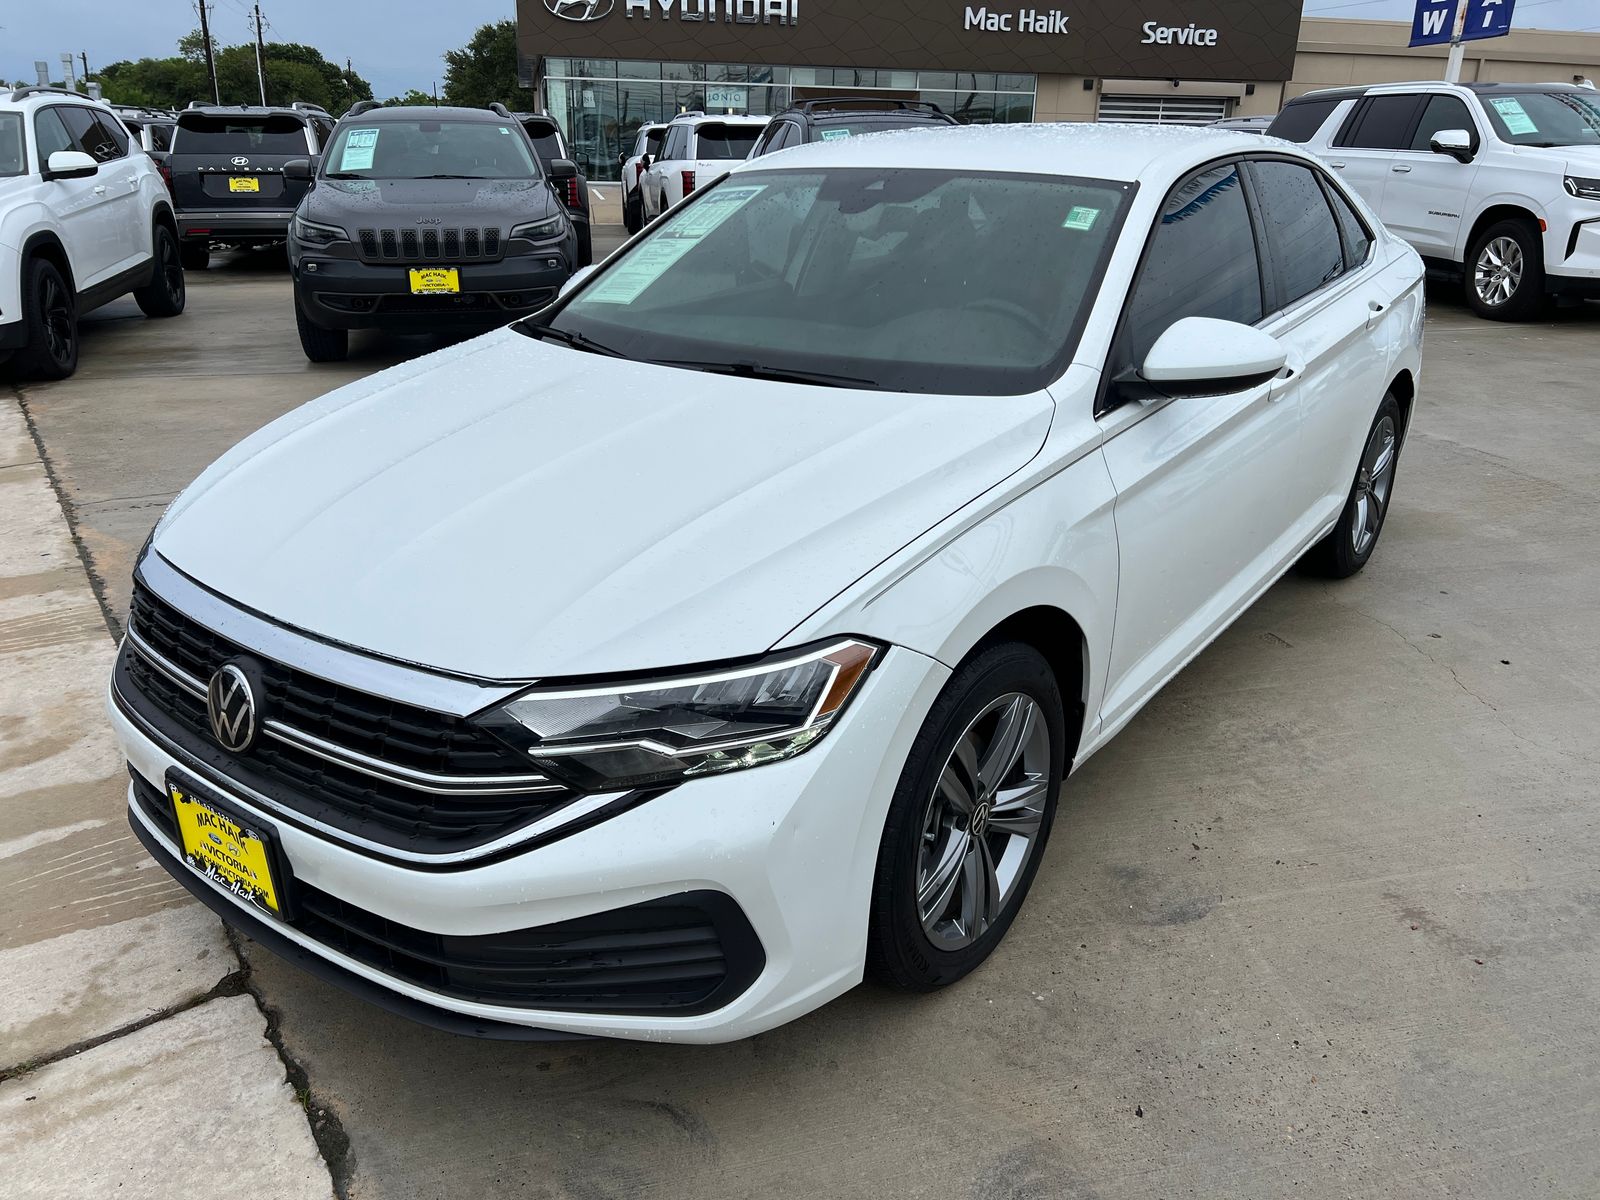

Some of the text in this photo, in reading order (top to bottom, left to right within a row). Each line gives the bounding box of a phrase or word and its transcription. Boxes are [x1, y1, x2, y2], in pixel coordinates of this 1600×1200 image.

[964, 6, 1070, 34] Mac Haik
[1141, 21, 1218, 46] Service
[416, 215, 442, 225] Jeep
[196, 812, 248, 856] MAC HAIK
[206, 842, 252, 877] VICTORIA
[205, 864, 230, 889] Mac
